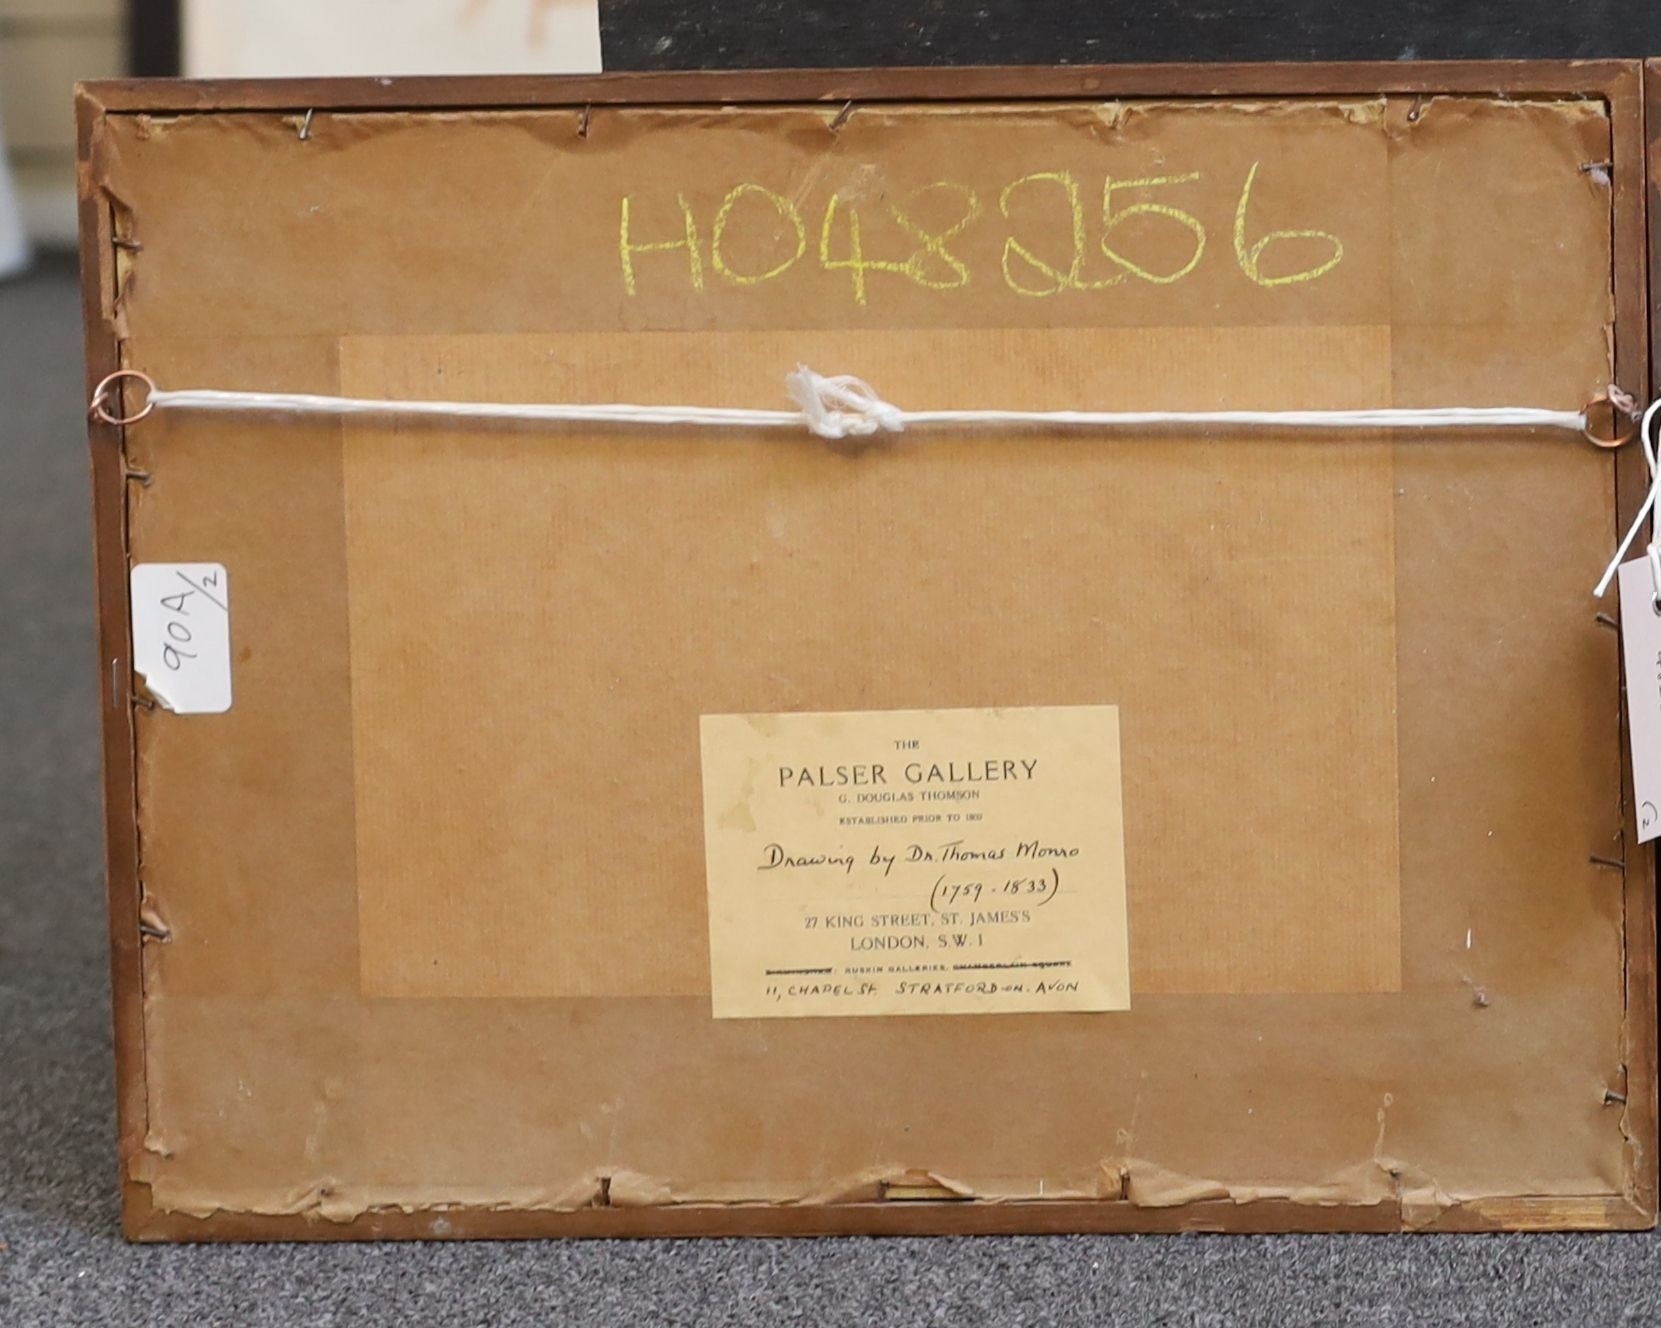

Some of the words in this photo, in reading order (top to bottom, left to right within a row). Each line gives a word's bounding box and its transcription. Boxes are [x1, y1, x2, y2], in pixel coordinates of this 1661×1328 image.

[895, 740, 920, 750] THE
[779, 763, 888, 788] PALSER
[904, 759, 1038, 784] GALLERY
[857, 792, 914, 804] DOUGLAS
[921, 790, 981, 801] THOMSON
[839, 815, 908, 826] ESTABLISHED
[912, 814, 942, 823] PRIOR
[947, 813, 960, 822] TO
[757, 843, 854, 875] Drawing
[869, 845, 896, 877] by
[939, 840, 1006, 862] Thomas
[1016, 840, 1080, 859] Monro
[804, 917, 818, 929] 27
[825, 915, 864, 929] KING
[871, 913, 934, 927] STREET,
[940, 912, 963, 926] ST.
[969, 910, 1031, 927] JAMES'S
[850, 935, 929, 951] LONDON,
[845, 966, 883, 974] RUSKIN
[788, 984, 854, 996] CHAPEL
